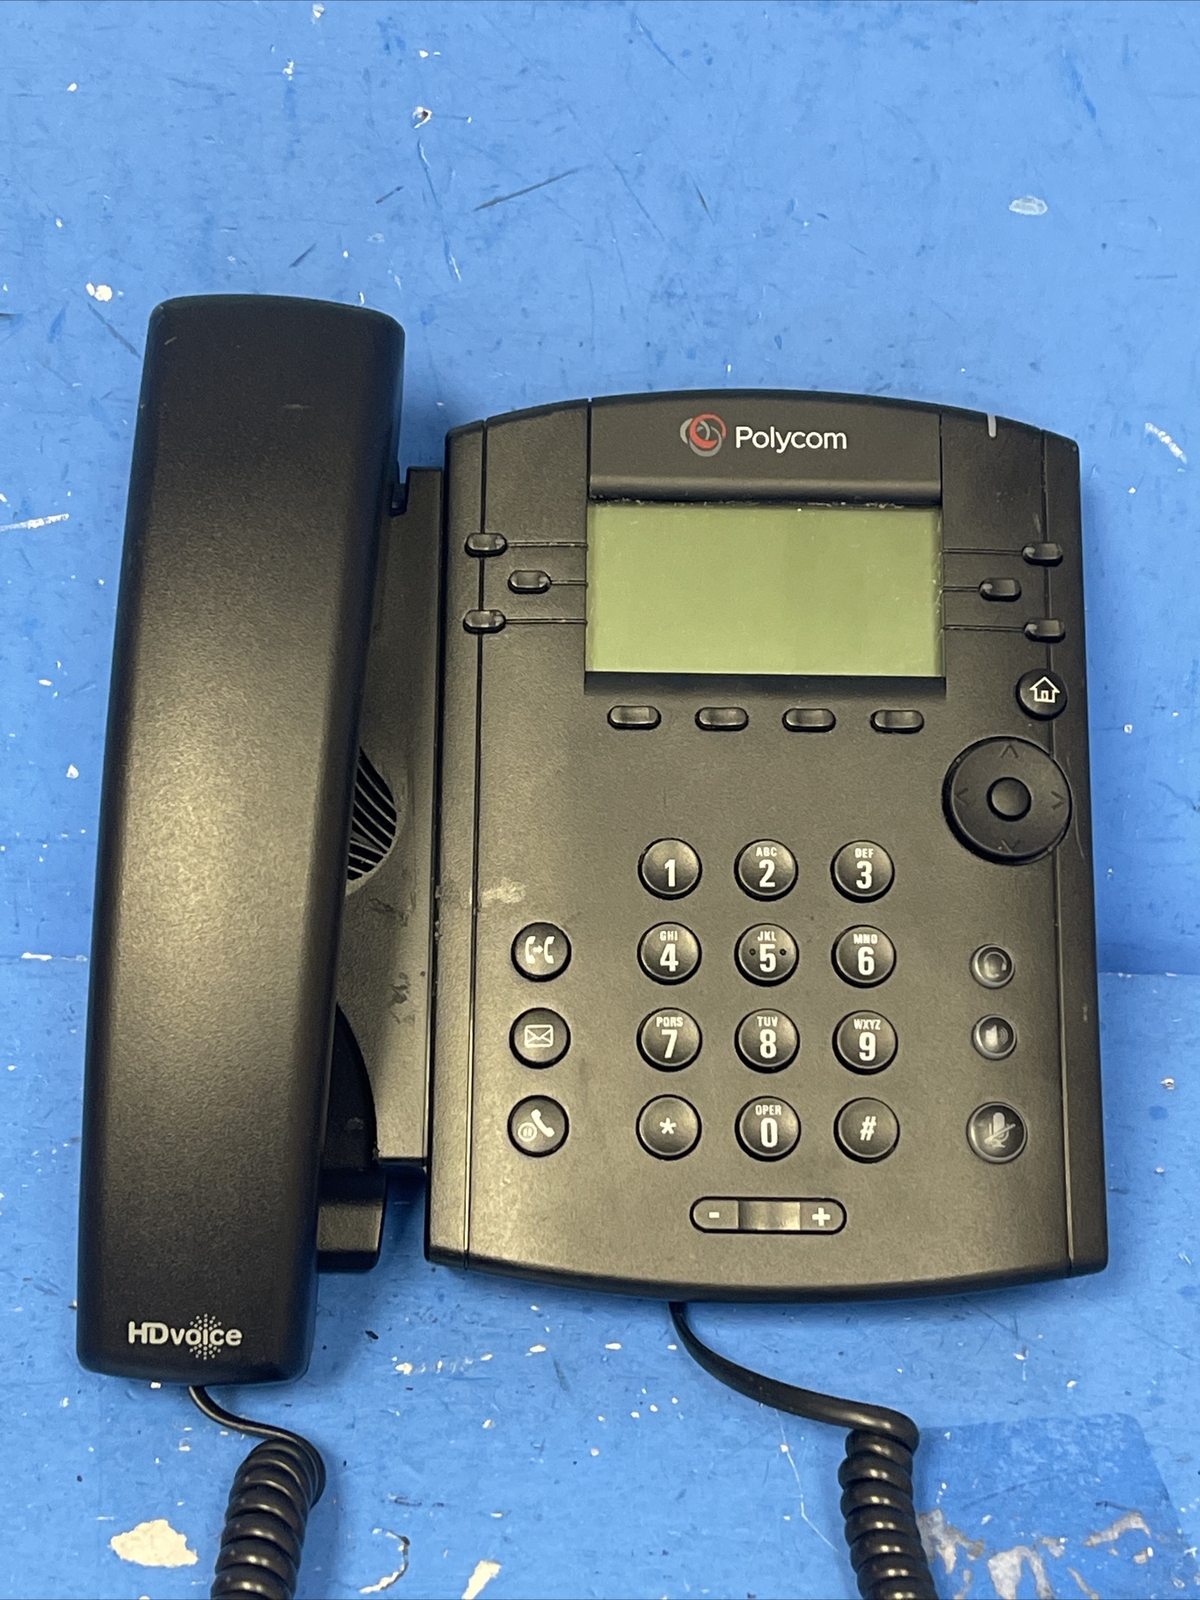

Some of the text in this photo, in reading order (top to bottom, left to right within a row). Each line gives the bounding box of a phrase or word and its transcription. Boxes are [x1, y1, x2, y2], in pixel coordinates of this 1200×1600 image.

[735, 425, 848, 454] Polycom
[755, 846, 778, 857] ABC
[854, 848, 874, 859] DEF
[663, 859, 676, 887] 1
[758, 858, 776, 888] 2
[855, 860, 873, 889] 3
[659, 930, 678, 942] GHI
[757, 930, 777, 942] JKL
[853, 933, 878, 945] MNO
[659, 943, 679, 972] 4
[759, 943, 777, 973] 5
[857, 946, 875, 976] 6
[656, 1016, 684, 1028] PQRS
[757, 1016, 778, 1027] TUV
[853, 1018, 881, 1031] WXYZ
[661, 1028, 678, 1059] 7
[759, 1028, 777, 1059] 8
[858, 1031, 876, 1061] 9
[755, 1104, 782, 1116] OPER
[760, 1117, 778, 1148] 0
[860, 1115, 877, 1141] #
